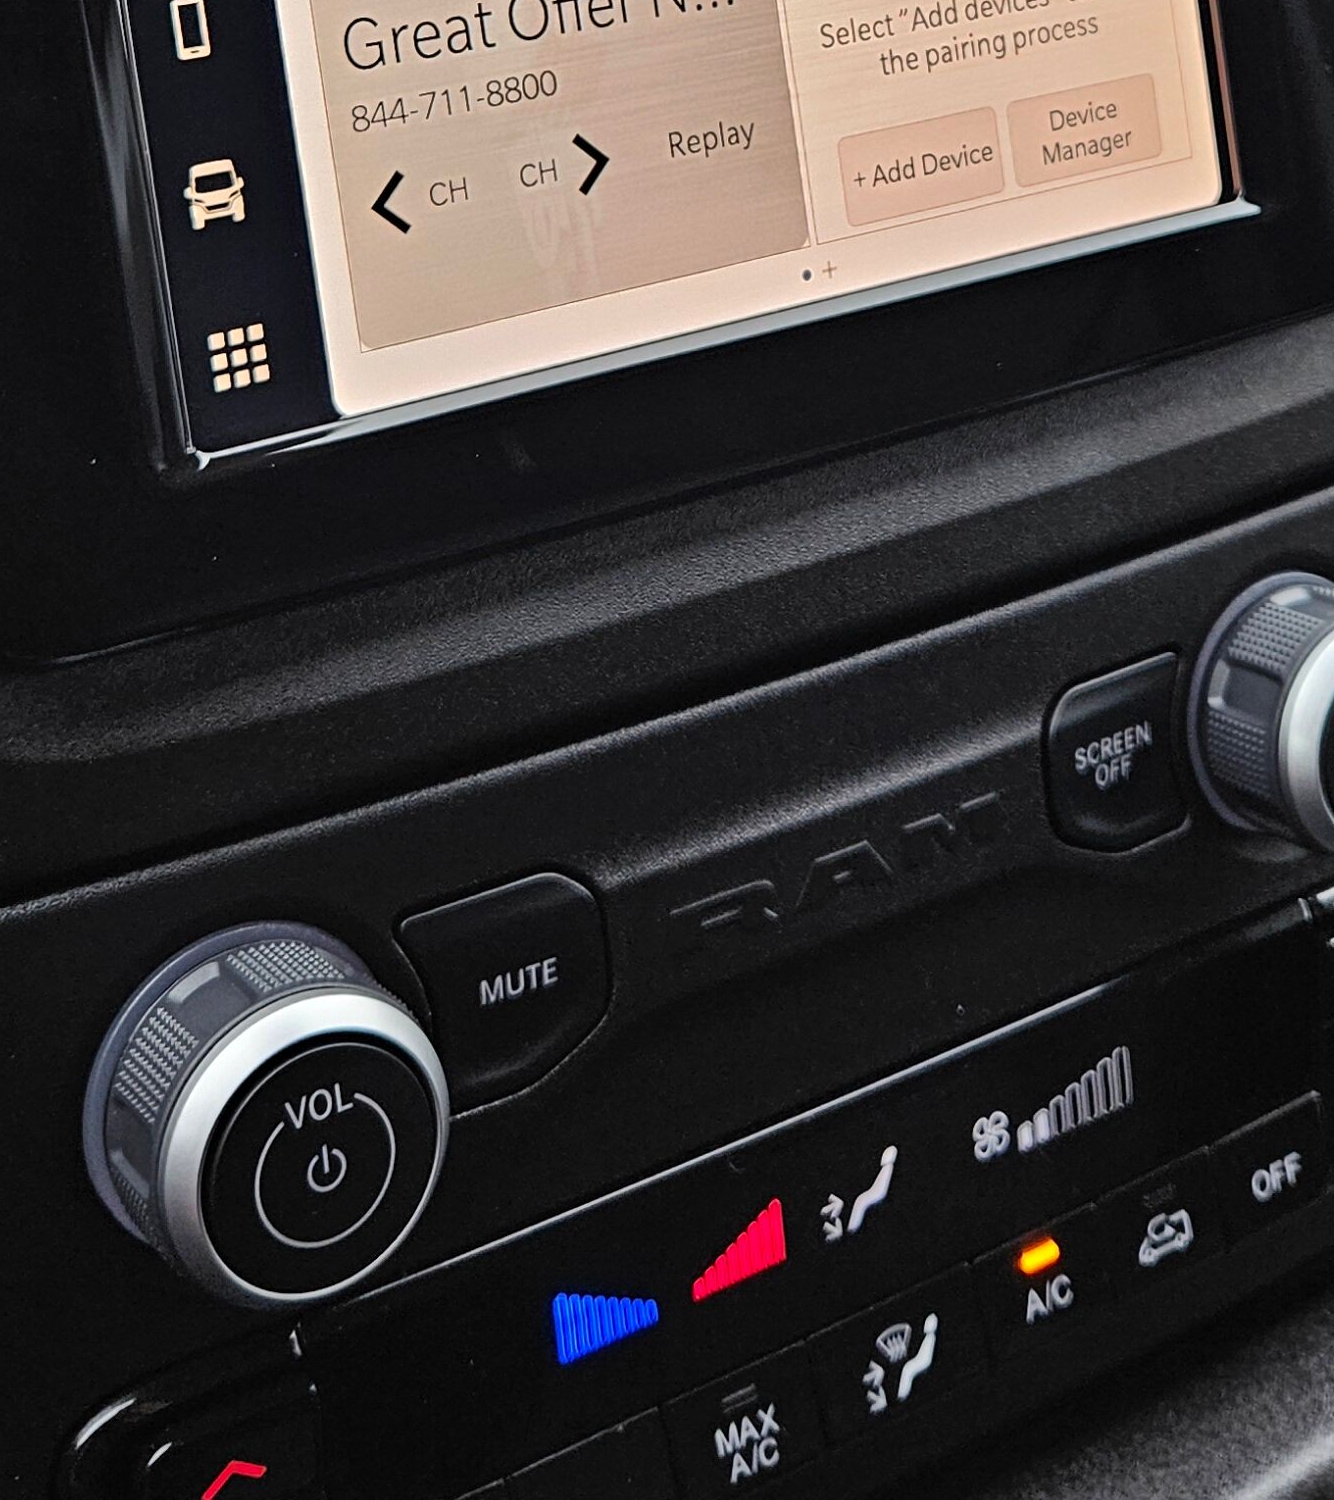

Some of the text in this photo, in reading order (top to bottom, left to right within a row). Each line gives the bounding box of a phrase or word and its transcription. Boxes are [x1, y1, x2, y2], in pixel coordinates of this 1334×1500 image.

[343, 2, 497, 70] Great
[819, 13, 896, 50] Select
[879, 13, 1100, 77] the pairing process
[351, 69, 558, 134] 844-711-8800
[1049, 100, 1119, 132] Device
[667, 121, 756, 159] Replay
[1041, 128, 1133, 166] Manager
[519, 158, 559, 189] CH
[871, 156, 916, 188] Add
[921, 142, 994, 176] Device
[429, 177, 470, 208] CH
[1074, 719, 1153, 775] SCREEN
[1094, 752, 1133, 791] OFF
[479, 957, 560, 1006] MUTE
[283, 1081, 357, 1130] VOL
[1250, 1151, 1304, 1203] OFF
[1025, 1273, 1075, 1325] A/C
[713, 1403, 781, 1458] MAX
[730, 1435, 781, 1485] A/C
